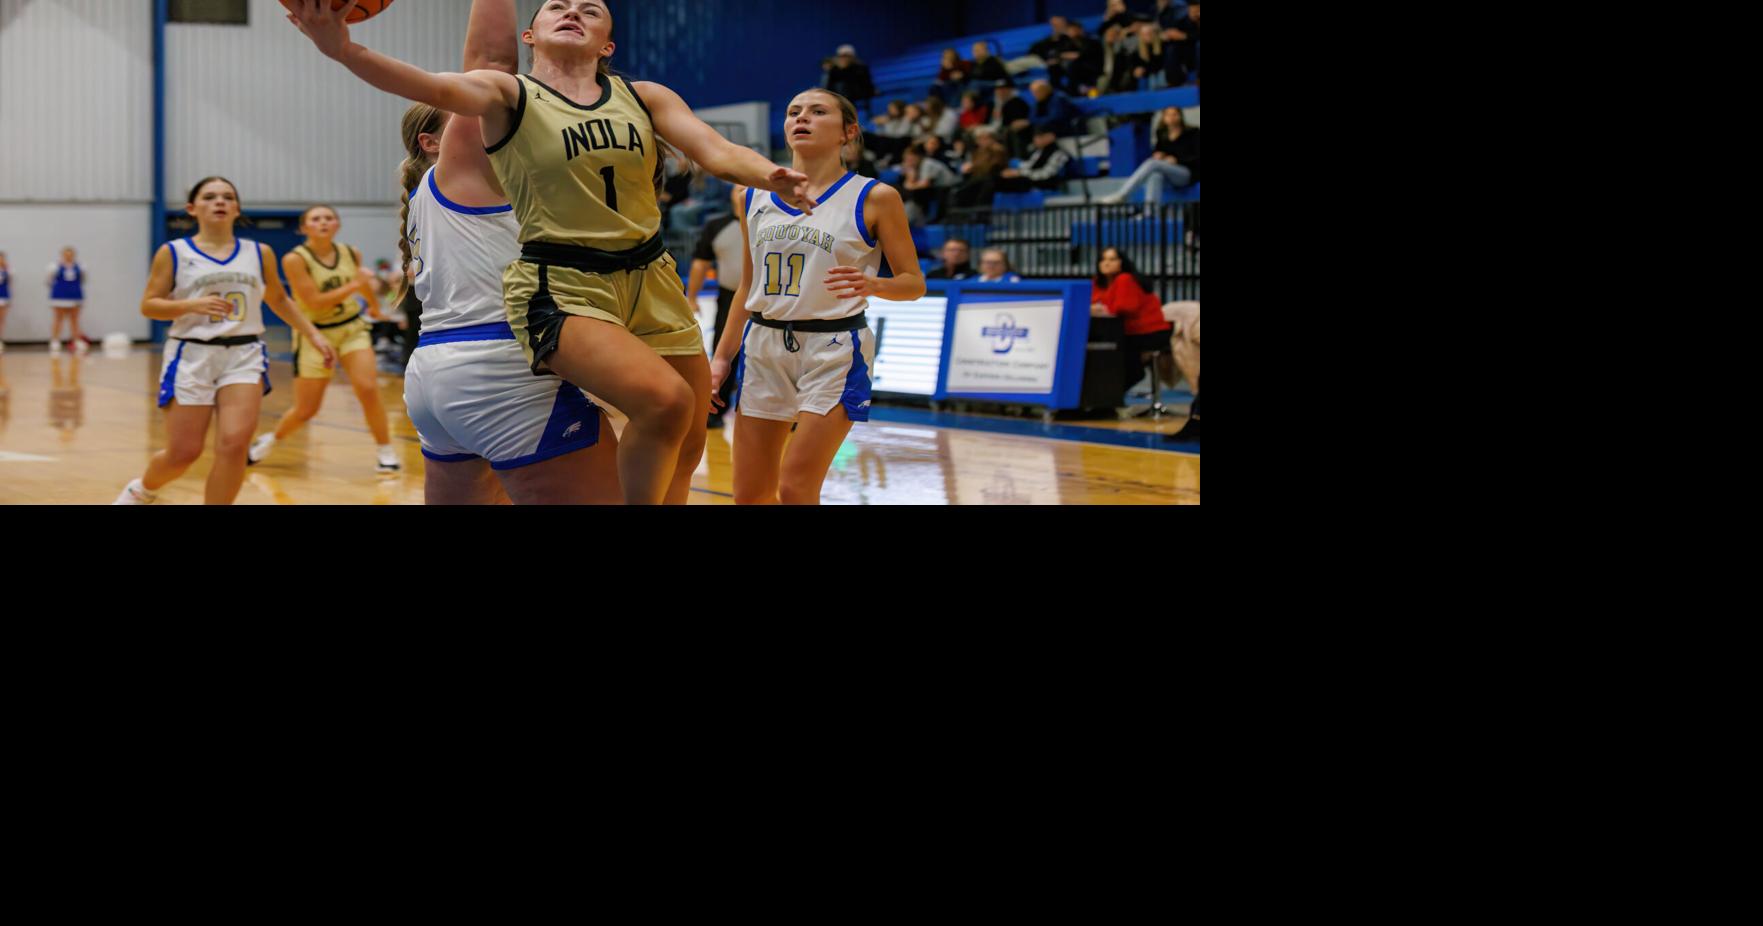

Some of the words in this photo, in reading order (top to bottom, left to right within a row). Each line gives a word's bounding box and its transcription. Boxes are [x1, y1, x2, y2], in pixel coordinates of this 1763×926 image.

[562, 118, 645, 161] INOLA
[599, 165, 618, 212] 1
[764, 251, 805, 297] 11
